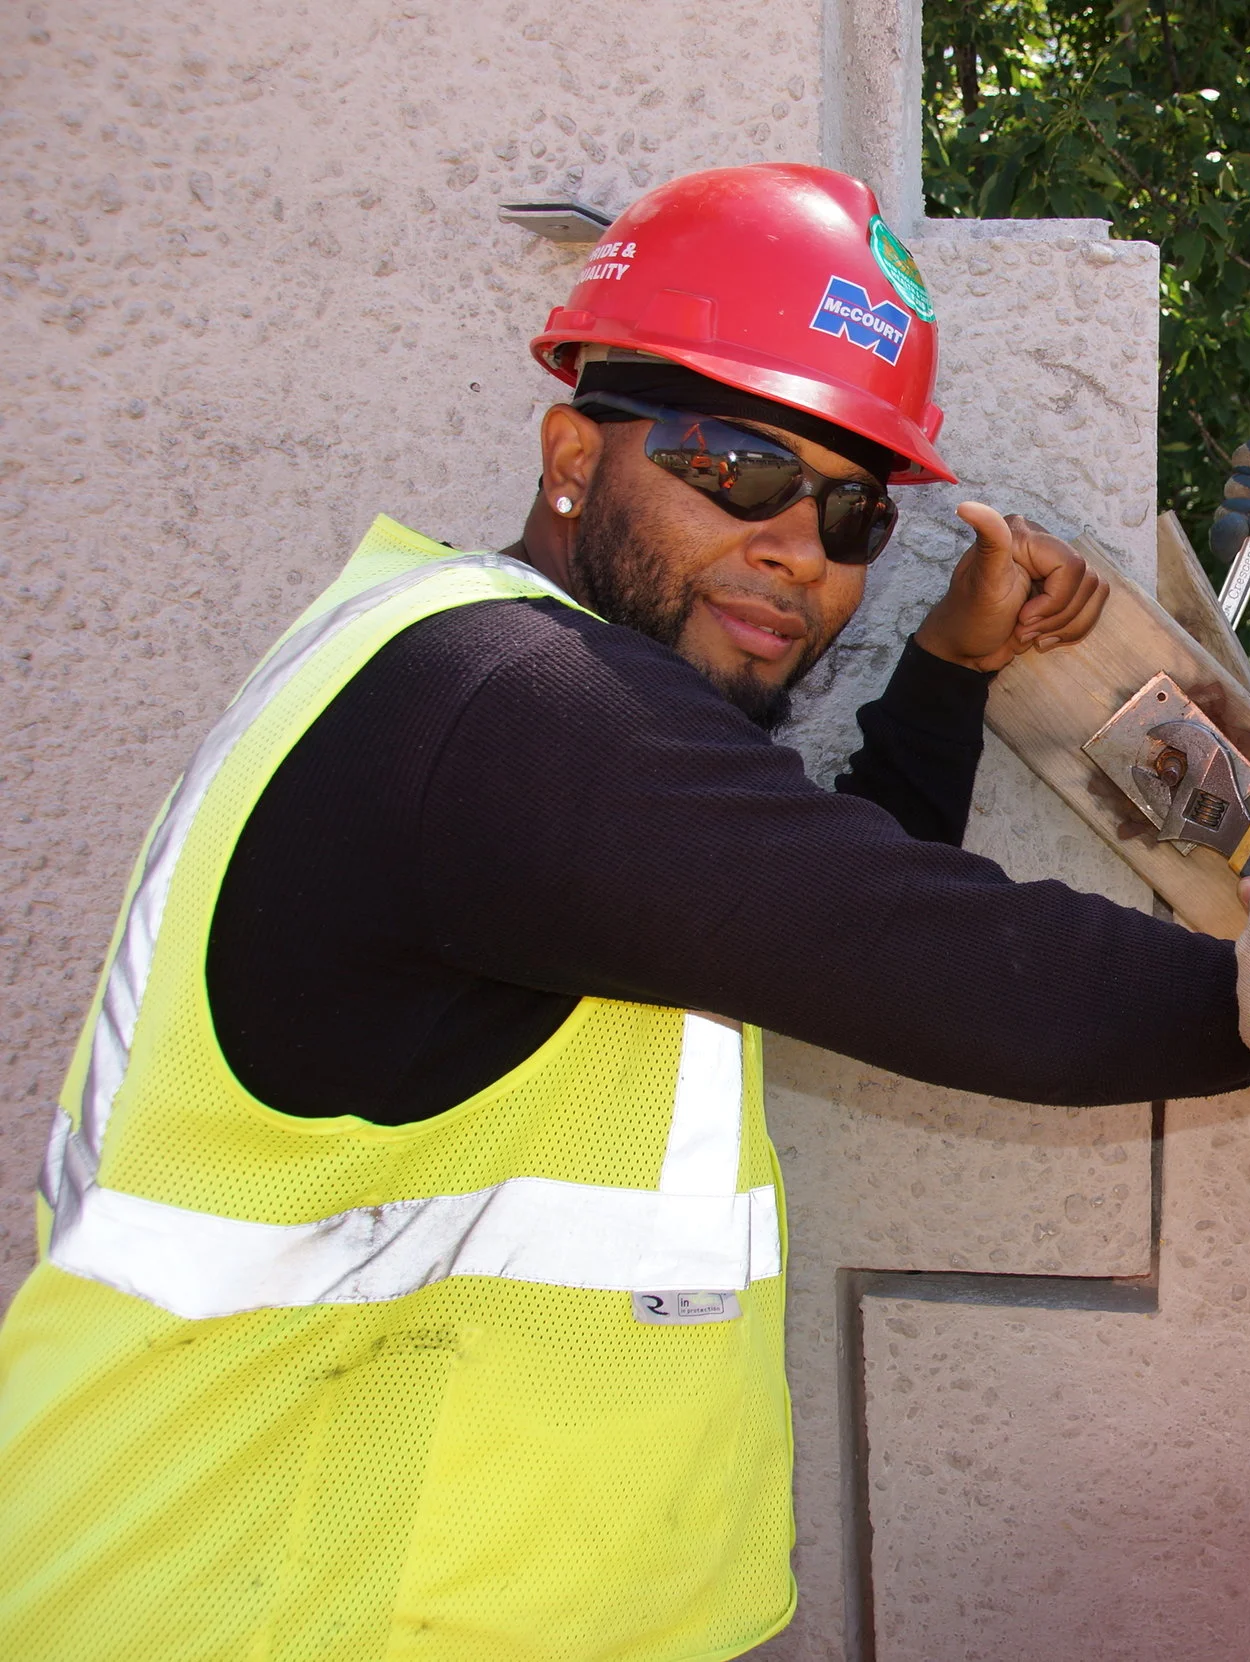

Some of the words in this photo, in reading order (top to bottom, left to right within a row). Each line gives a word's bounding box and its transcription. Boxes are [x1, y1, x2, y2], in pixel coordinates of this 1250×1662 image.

[621, 242, 637, 258] &
[576, 263, 630, 285] UALITY
[823, 297, 903, 344] McCOURT
[687, 1306, 721, 1314] protection
